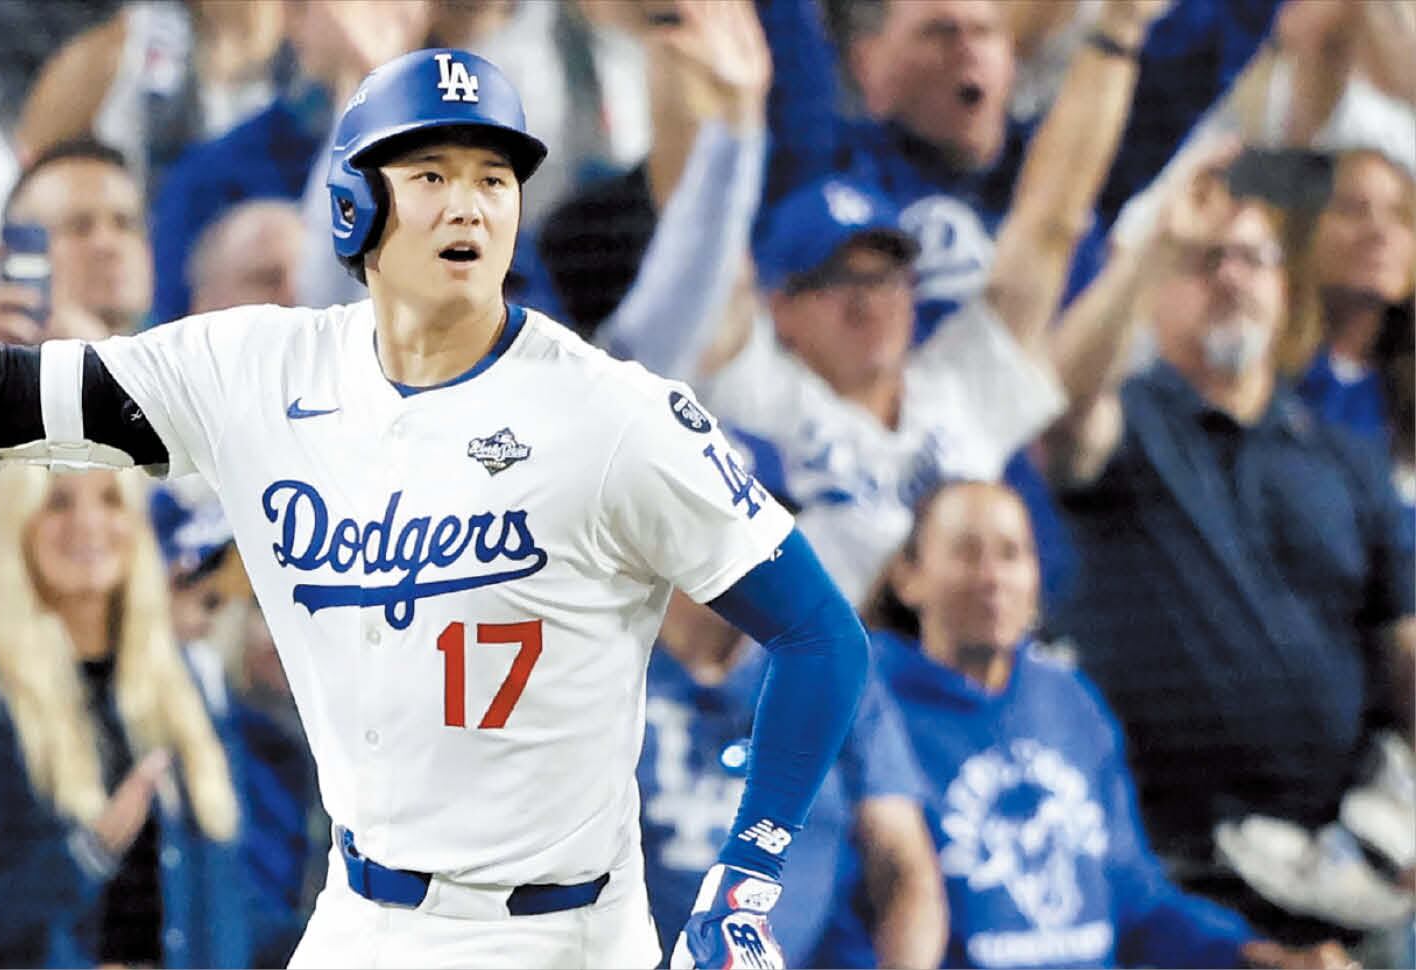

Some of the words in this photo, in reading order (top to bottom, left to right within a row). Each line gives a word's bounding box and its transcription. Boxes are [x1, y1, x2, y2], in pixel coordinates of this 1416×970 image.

[434, 53, 479, 102] LA
[703, 443, 766, 519] LA
[262, 480, 548, 630] Dodgers
[437, 619, 543, 730] 17
